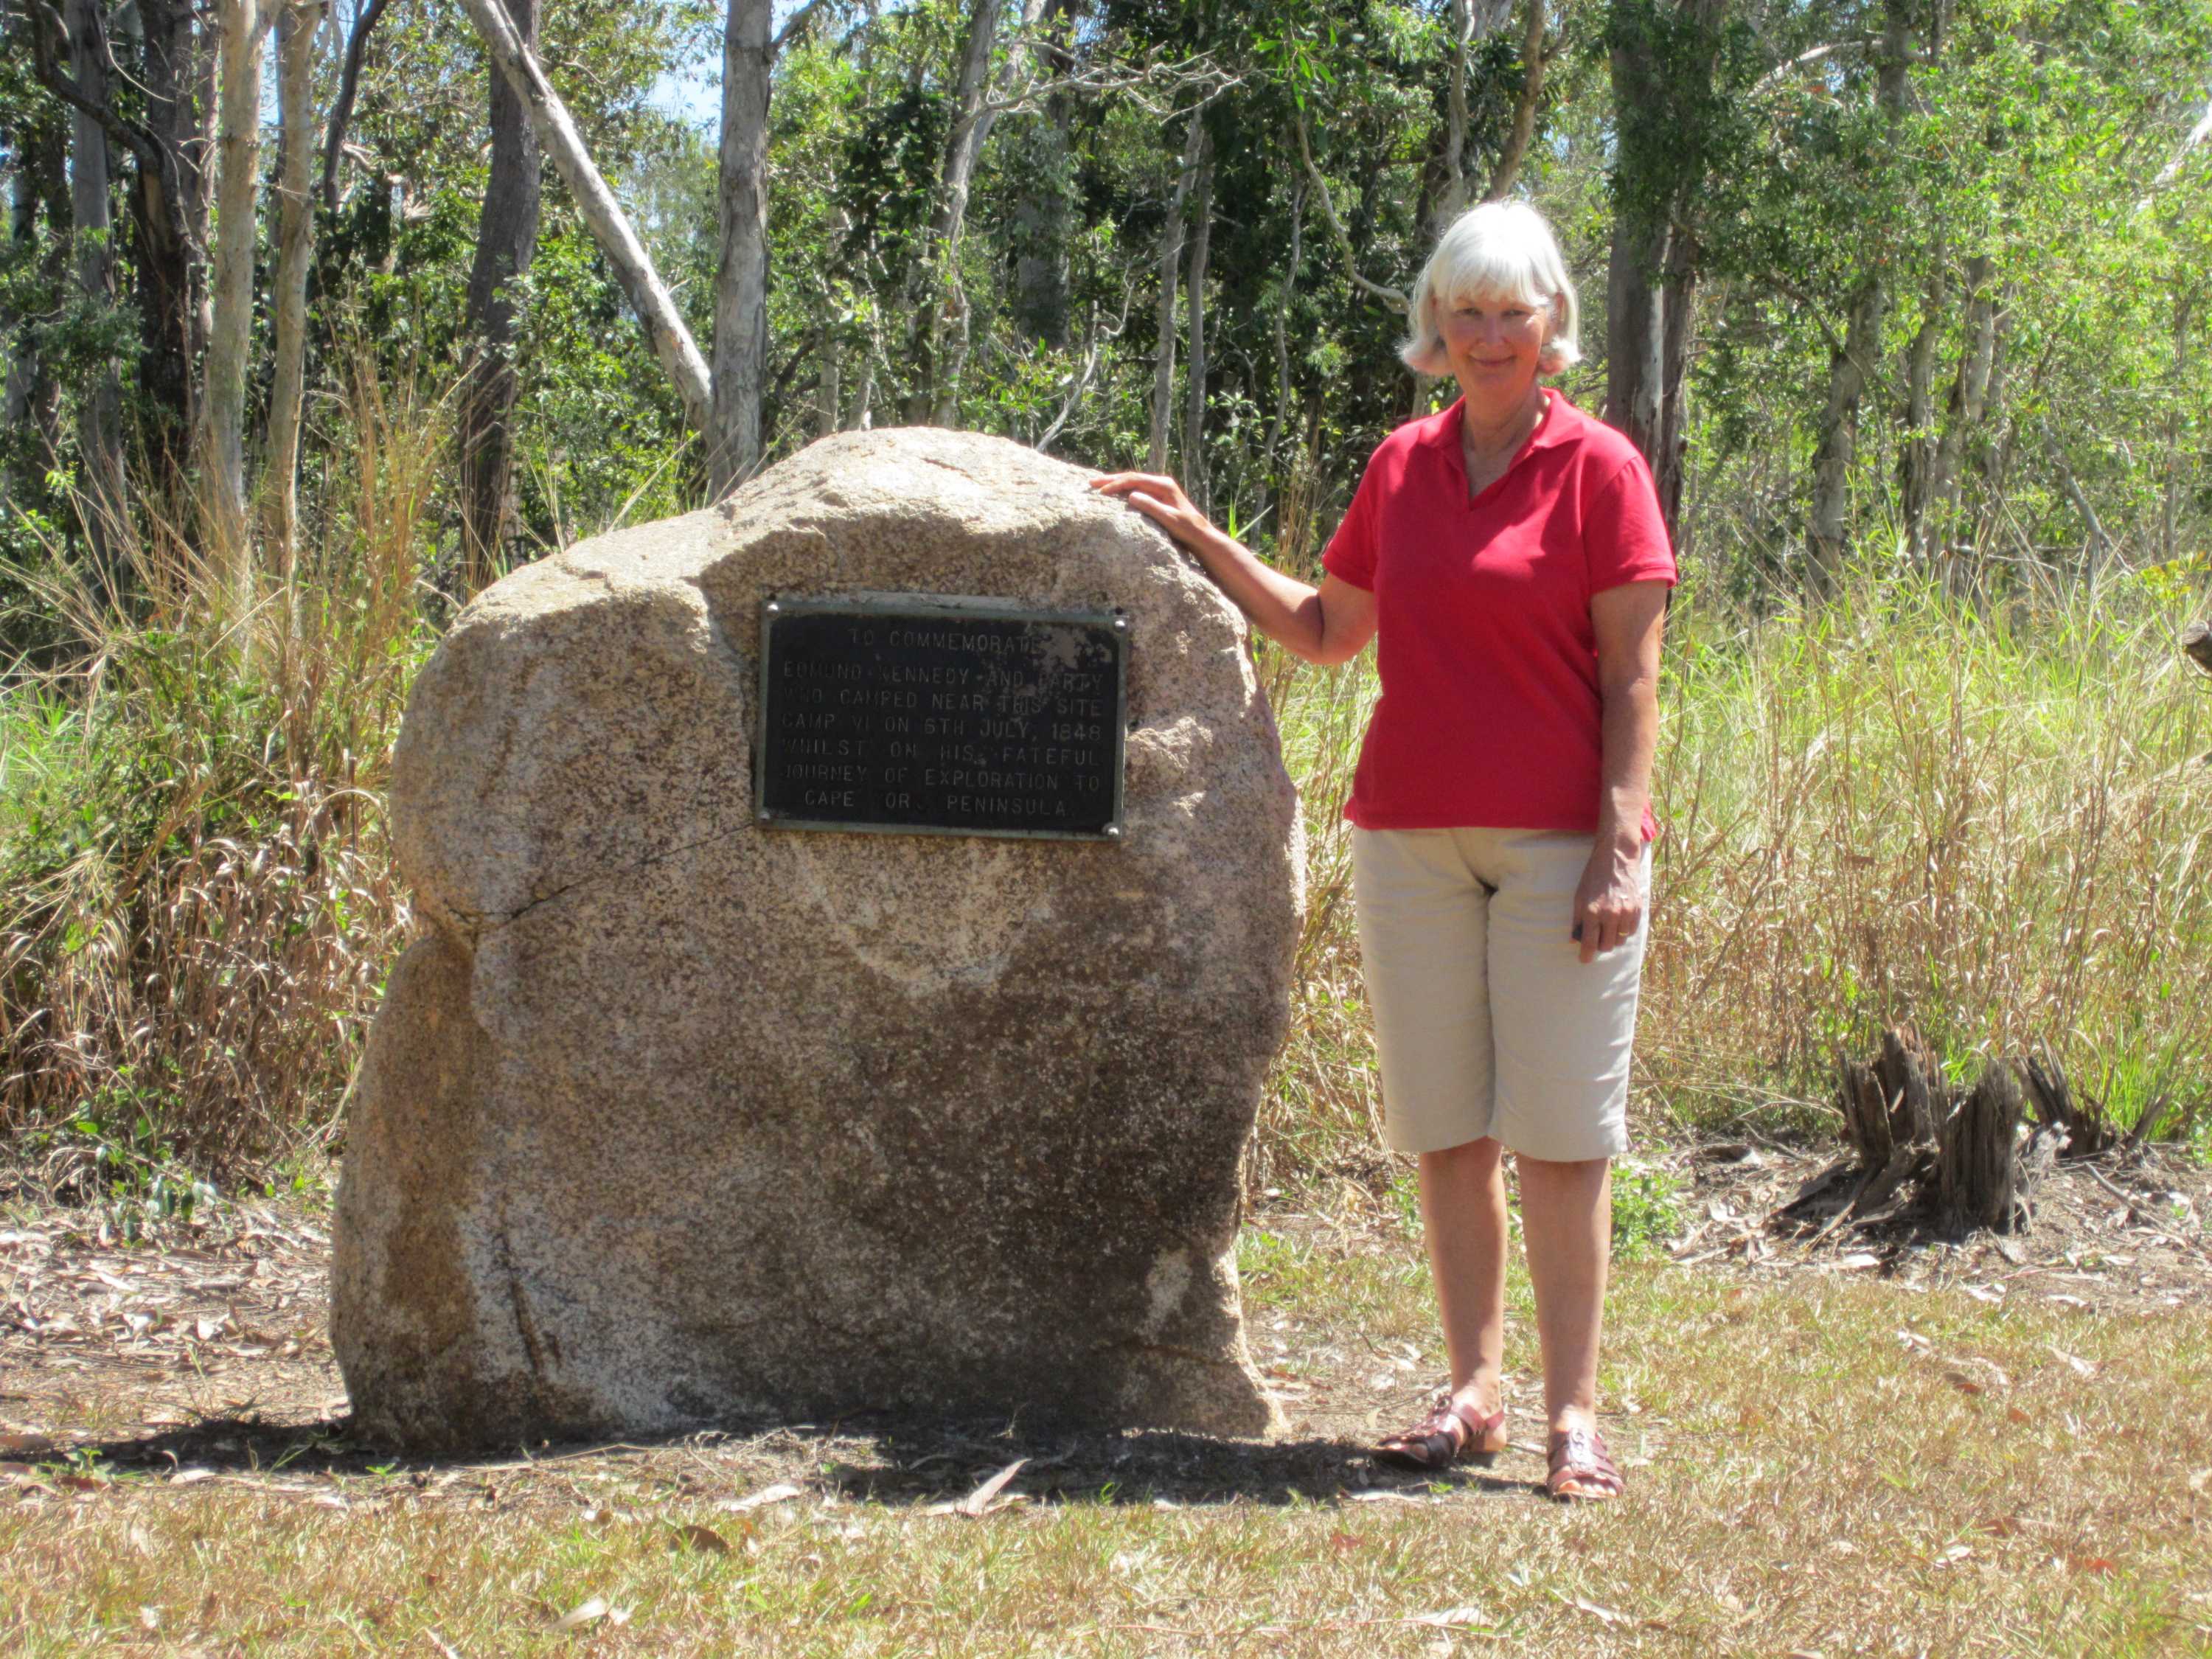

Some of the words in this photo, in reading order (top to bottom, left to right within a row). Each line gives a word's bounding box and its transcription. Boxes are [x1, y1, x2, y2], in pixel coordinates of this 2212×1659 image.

[847, 627, 874, 647] TO
[784, 660, 861, 679] EDMUND
[878, 665, 970, 686] KENNEDY
[987, 669, 1023, 686] AND
[839, 689, 917, 709] CAMPED
[931, 692, 984, 713] NEAR
[998, 695, 1042, 714] THIS
[1057, 698, 1103, 717] SITE
[782, 713, 836, 731] CAMP
[885, 715, 909, 733] ON
[924, 717, 964, 737] 6TH
[1051, 723, 1102, 741] 1848
[782, 737, 866, 756] WHILST
[890, 740, 917, 759] ON
[1003, 747, 1102, 767] FATEFUL
[784, 764, 868, 782] JOURNEY
[885, 767, 908, 784] OF
[925, 768, 1058, 790] EXPLORATION
[1074, 774, 1100, 792] TO
[804, 790, 855, 808] CAPE
